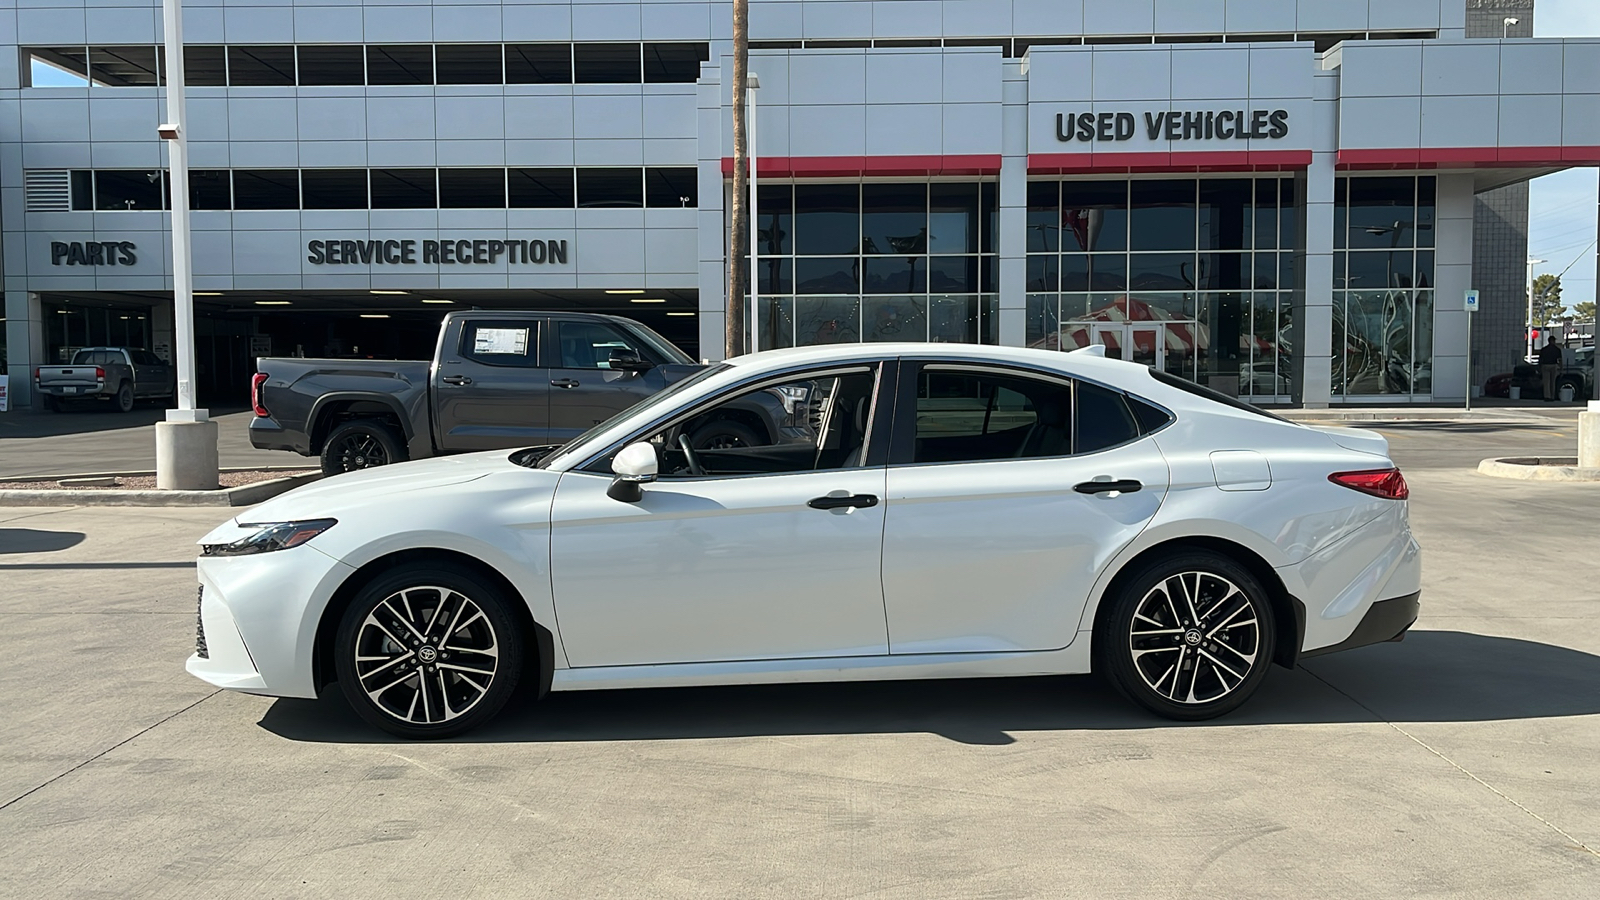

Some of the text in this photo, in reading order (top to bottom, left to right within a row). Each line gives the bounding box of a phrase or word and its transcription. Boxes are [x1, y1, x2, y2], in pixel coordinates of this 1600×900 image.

[1056, 110, 1288, 142] USED VEHICLES
[51, 241, 136, 265] PARTS
[307, 239, 568, 265] SERVICE RECEPTION
